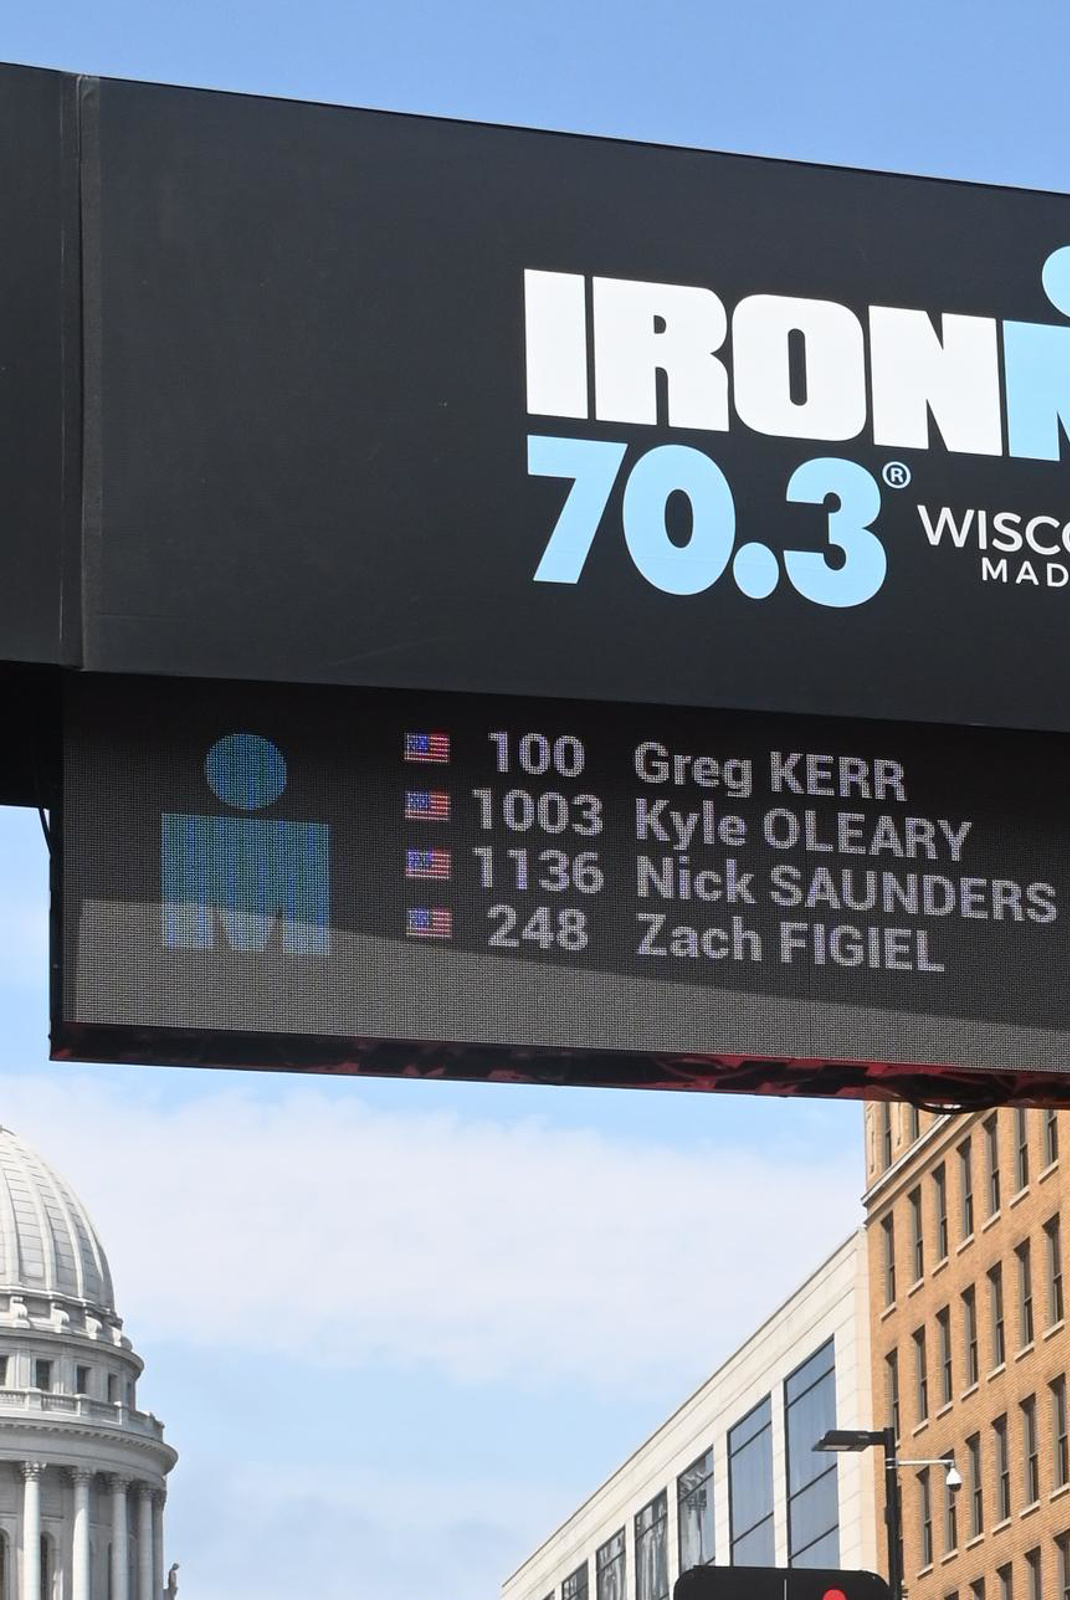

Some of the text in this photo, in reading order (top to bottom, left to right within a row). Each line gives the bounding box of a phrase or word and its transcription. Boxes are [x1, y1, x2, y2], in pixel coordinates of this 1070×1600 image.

[527, 435, 887, 608] 70.3
[488, 731, 586, 778] 100
[634, 741, 752, 798] Greg
[768, 750, 906, 803] KERR
[472, 789, 604, 838] 1003
[635, 799, 746, 855] Kyle
[764, 809, 973, 864] OLEARY
[472, 848, 604, 896] 1136
[638, 854, 752, 905] Nick
[769, 867, 1057, 924] SAUNDERS
[486, 907, 589, 953] 248
[637, 912, 763, 963] Zach
[779, 923, 944, 975] FIGIEL
